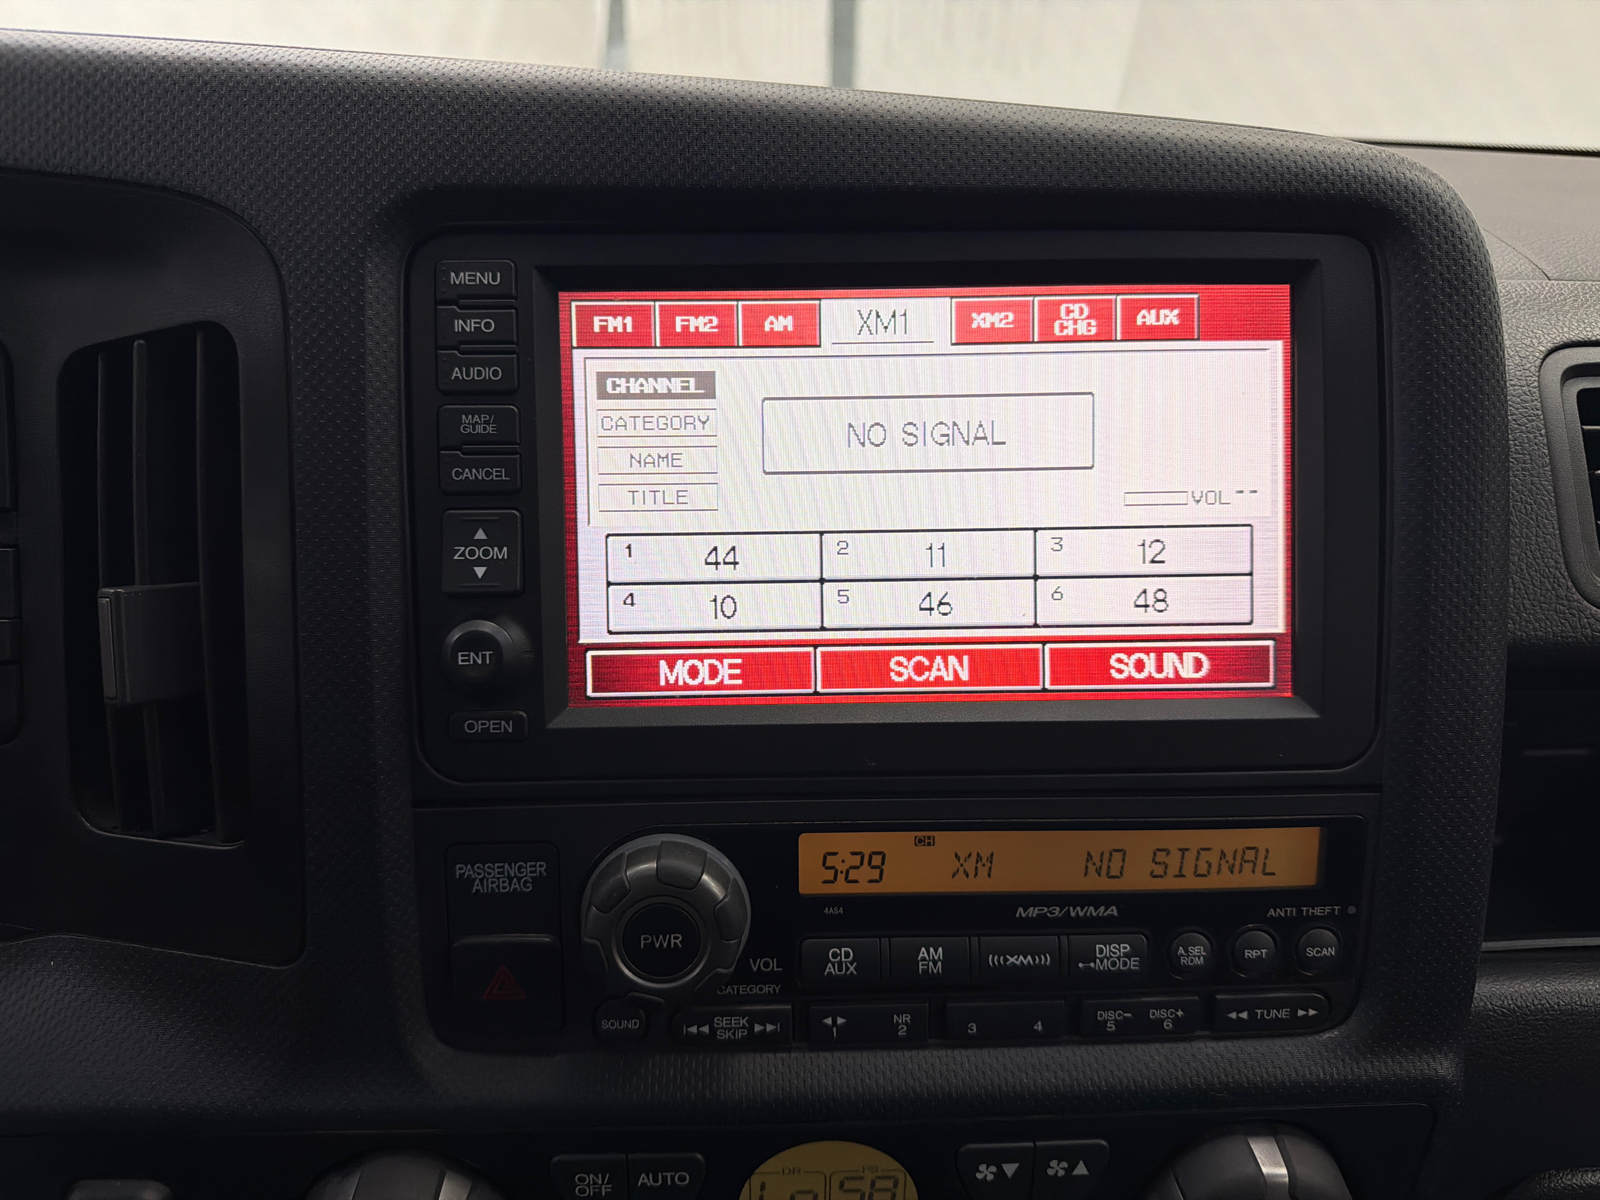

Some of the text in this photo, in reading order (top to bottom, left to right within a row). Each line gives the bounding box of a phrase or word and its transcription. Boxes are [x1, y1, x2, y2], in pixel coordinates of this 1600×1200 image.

[450, 272, 501, 285] MENU
[1060, 303, 1089, 320] CD
[1136, 308, 1180, 326] AUX
[454, 319, 495, 333] INFO
[593, 316, 633, 333] FM1
[675, 316, 719, 333] FM2
[764, 315, 793, 332] AM
[857, 309, 908, 335] XM1
[971, 311, 1014, 329] XM2
[1054, 319, 1097, 336] CHG
[451, 367, 502, 380] AUDIO
[606, 377, 705, 394] CHANNEL
[462, 414, 494, 424] MAP/
[601, 414, 710, 431] CATEGORY
[460, 424, 497, 434] GUIDE
[848, 420, 1006, 448] NO SIGNAL
[629, 453, 683, 468] NAME
[451, 467, 510, 481] CANCEL
[628, 489, 688, 505] TITLE
[1192, 490, 1231, 505] VOL
[624, 543, 633, 558] 1
[836, 540, 849, 555] 2
[1050, 536, 1064, 552] 3
[453, 546, 508, 560] ZOOM
[704, 545, 740, 571] 44
[926, 542, 945, 568] 11
[1138, 538, 1166, 565] 12
[623, 592, 636, 607] 4
[837, 589, 850, 604] 5
[1051, 586, 1064, 601] 6
[1134, 587, 1169, 613] 48
[709, 594, 737, 620] 10
[919, 591, 953, 617] 46
[457, 651, 494, 665] ENT
[658, 658, 743, 686] MODE
[889, 655, 969, 682] SCAN
[1109, 651, 1210, 680] SOUND
[464, 720, 513, 733] OPEN
[914, 835, 935, 847] CH
[821, 850, 887, 884] 5:29
[951, 851, 995, 879] XM
[1083, 846, 1276, 879] NO SIGNAL
[455, 862, 547, 879] PASSENGER
[472, 877, 533, 893] AIRBAG
[824, 906, 844, 915] 4AS4
[1015, 905, 1119, 918] MP3/WMA
[1266, 906, 1341, 918] ANTI THEFT
[640, 934, 683, 948] PWR
[828, 948, 853, 961] CD
[917, 947, 943, 960] AM
[1095, 944, 1130, 957] DISP
[1177, 946, 1207, 956] A.SEL
[1244, 949, 1267, 959] RPT
[1306, 947, 1336, 957] SCAN
[749, 957, 783, 972] VOL
[824, 962, 857, 975] AUX
[918, 961, 942, 974] FM
[1095, 958, 1139, 970] MODE
[1180, 957, 1204, 966] RDM
[893, 1014, 911, 1023] NR
[1255, 1009, 1290, 1020] TUNE
[601, 1018, 640, 1030] SOUND
[713, 1016, 749, 1028] SEEK
[967, 1023, 977, 1033] 3
[1033, 1021, 1043, 1031] 4
[1106, 1021, 1115, 1031] 5
[1163, 1019, 1172, 1030] 6
[716, 1029, 748, 1040] SKIP
[832, 1027, 837, 1037] 1
[898, 1025, 907, 1035] 2
[575, 1173, 609, 1186] ON/
[637, 1172, 690, 1186] AUTO
[575, 1184, 612, 1197] OFF
